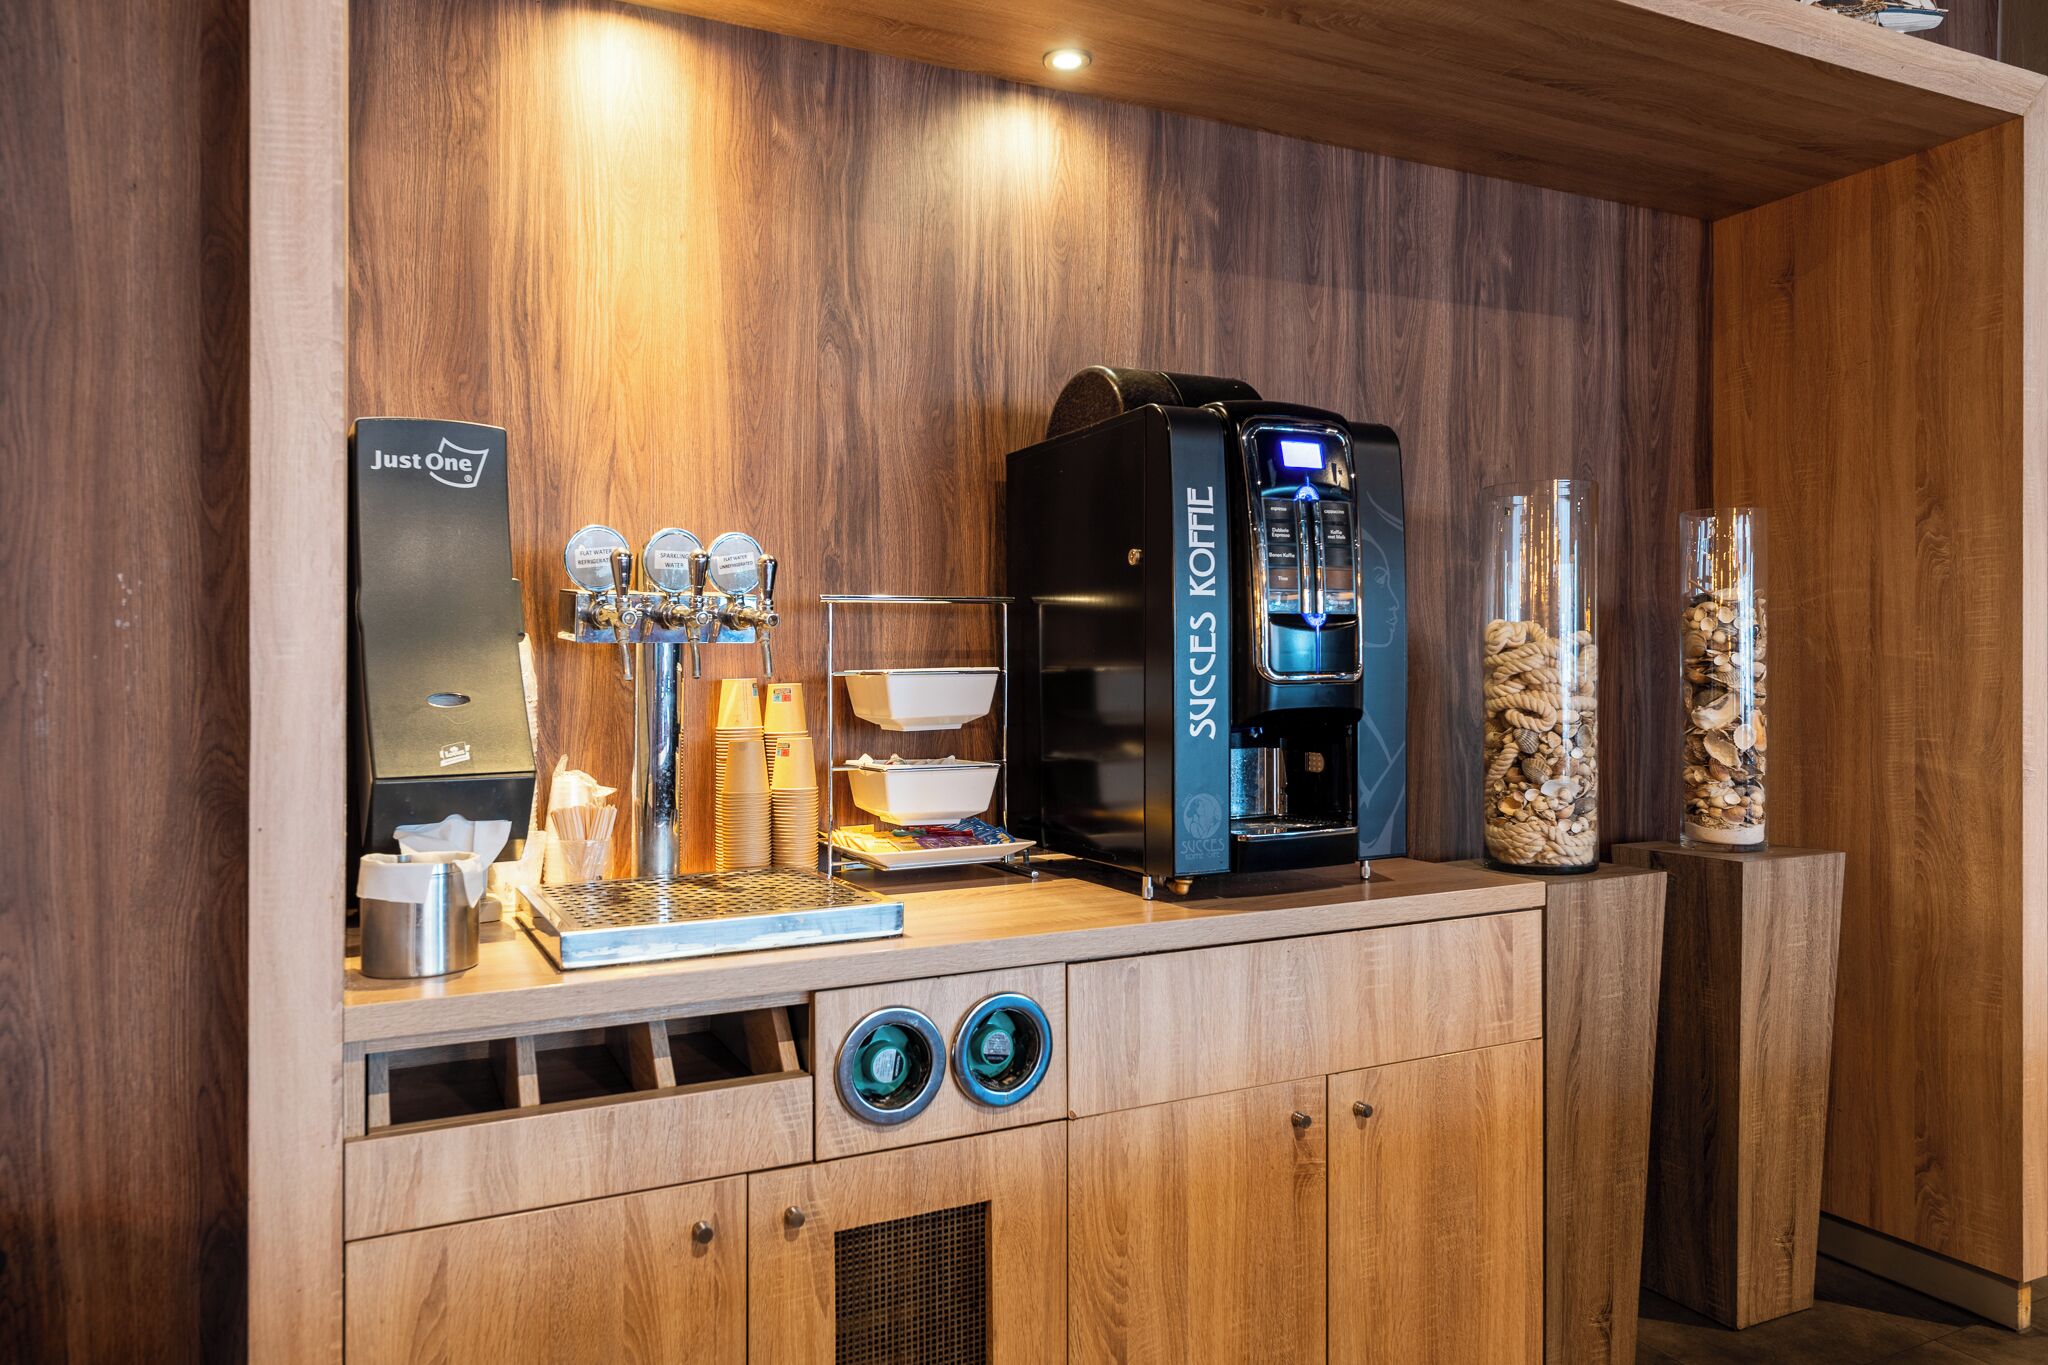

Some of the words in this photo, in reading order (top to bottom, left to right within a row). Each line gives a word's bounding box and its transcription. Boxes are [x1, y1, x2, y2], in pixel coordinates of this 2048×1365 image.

[370, 449, 422, 470] Just
[425, 452, 473, 472] One
[1186, 486, 1217, 597] KOFFIE
[577, 557, 609, 565] REFRIGERAT
[719, 560, 754, 570] UNREFRIGERATED
[1189, 611, 1217, 740] SUCCES
[1180, 838, 1225, 855] SUCCES
